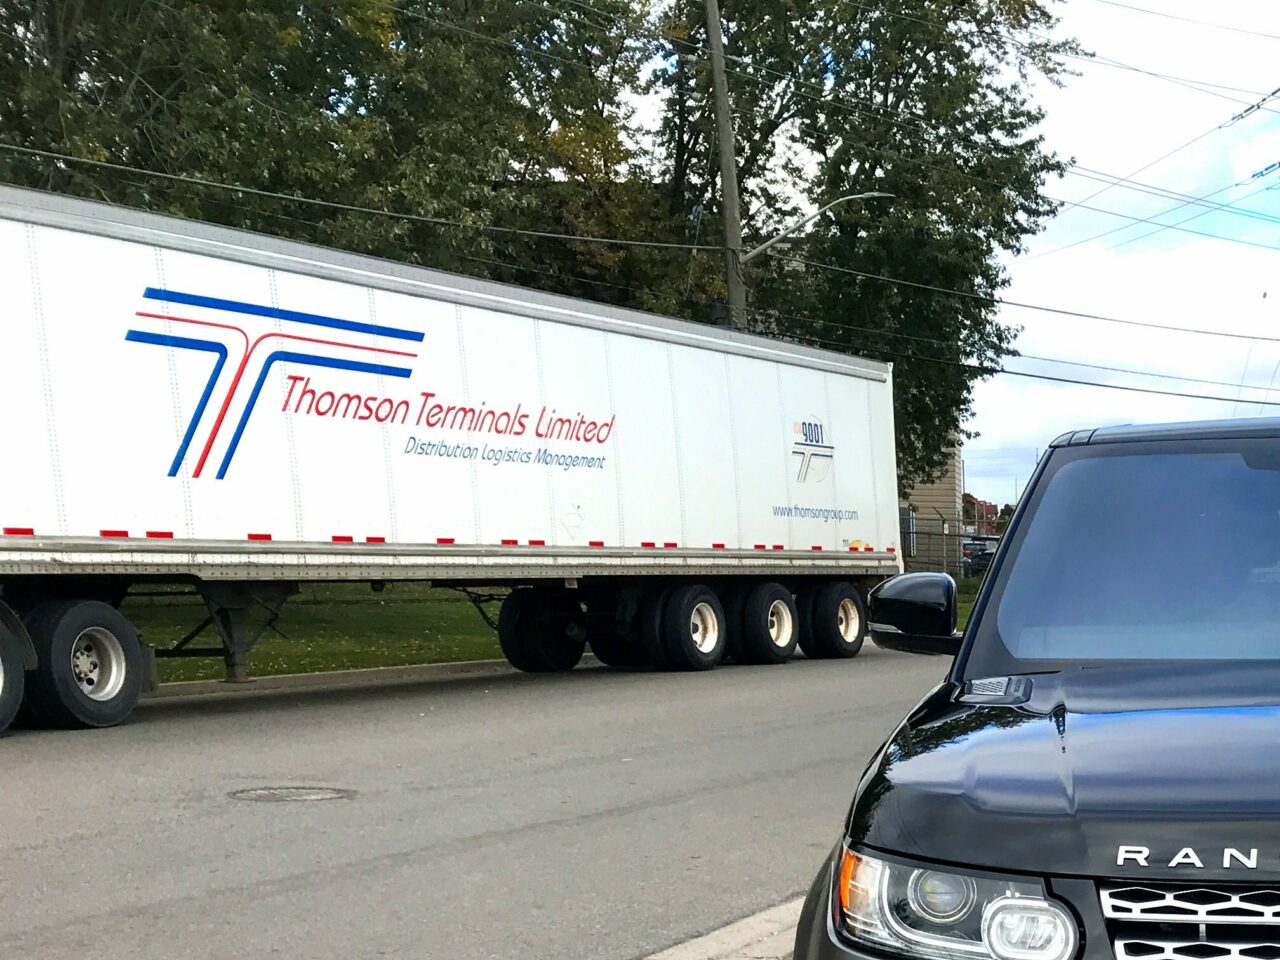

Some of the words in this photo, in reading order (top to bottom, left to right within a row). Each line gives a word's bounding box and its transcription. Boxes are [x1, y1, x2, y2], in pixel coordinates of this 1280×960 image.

[281, 374, 410, 425] Thomson
[415, 391, 529, 436] Terminals
[535, 405, 616, 444] Limited
[801, 421, 824, 444] 9001
[404, 436, 479, 460] Distribution
[481, 443, 532, 466] Logistics
[533, 447, 606, 471] Management
[772, 504, 859, 523] www.thomsongroup.com
